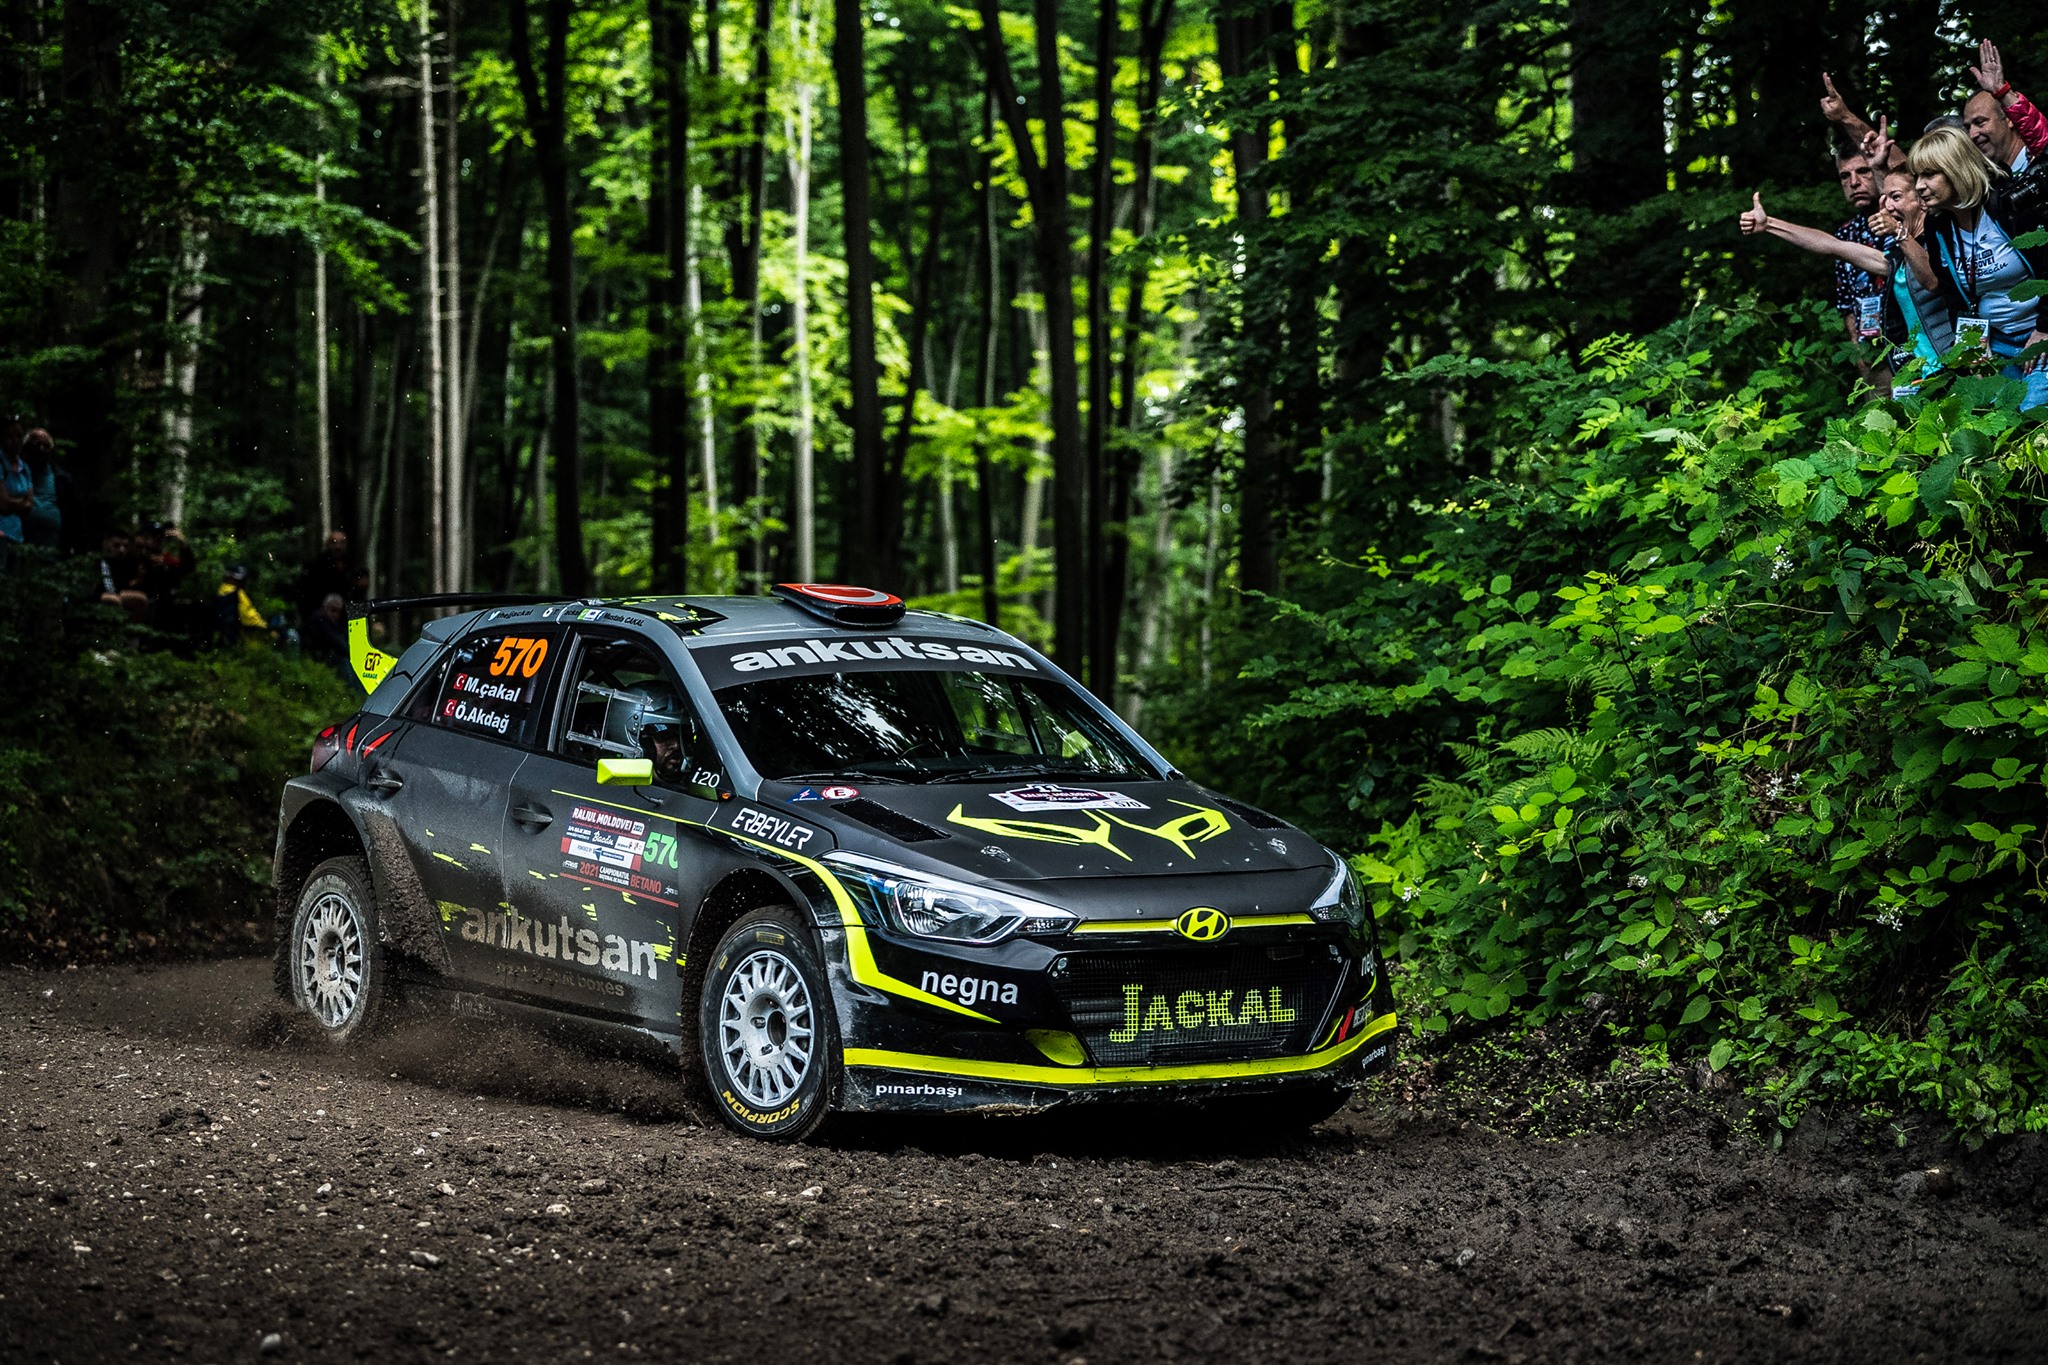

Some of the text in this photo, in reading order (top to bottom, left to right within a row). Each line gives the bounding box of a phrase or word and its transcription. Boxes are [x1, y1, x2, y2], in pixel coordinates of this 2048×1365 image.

[490, 637, 548, 678] 570
[730, 637, 1038, 672] ankutsan
[464, 676, 521, 702] M.çakal
[455, 700, 510, 734] Ö.Akdağ
[691, 767, 720, 788] i20
[834, 788, 847, 797] E
[572, 807, 596, 823] RALIUL
[595, 813, 632, 831] MOLDOVEI
[731, 807, 814, 850] ERBEYLER
[579, 861, 599, 878] 2021
[599, 866, 630, 880] CAMPIONATUL
[629, 874, 662, 894] BETANO
[460, 905, 658, 980] ankutsan
[921, 971, 1018, 1005] negna
[876, 1083, 963, 1097] pınarbaşı
[721, 1089, 801, 1124] SCORPION
